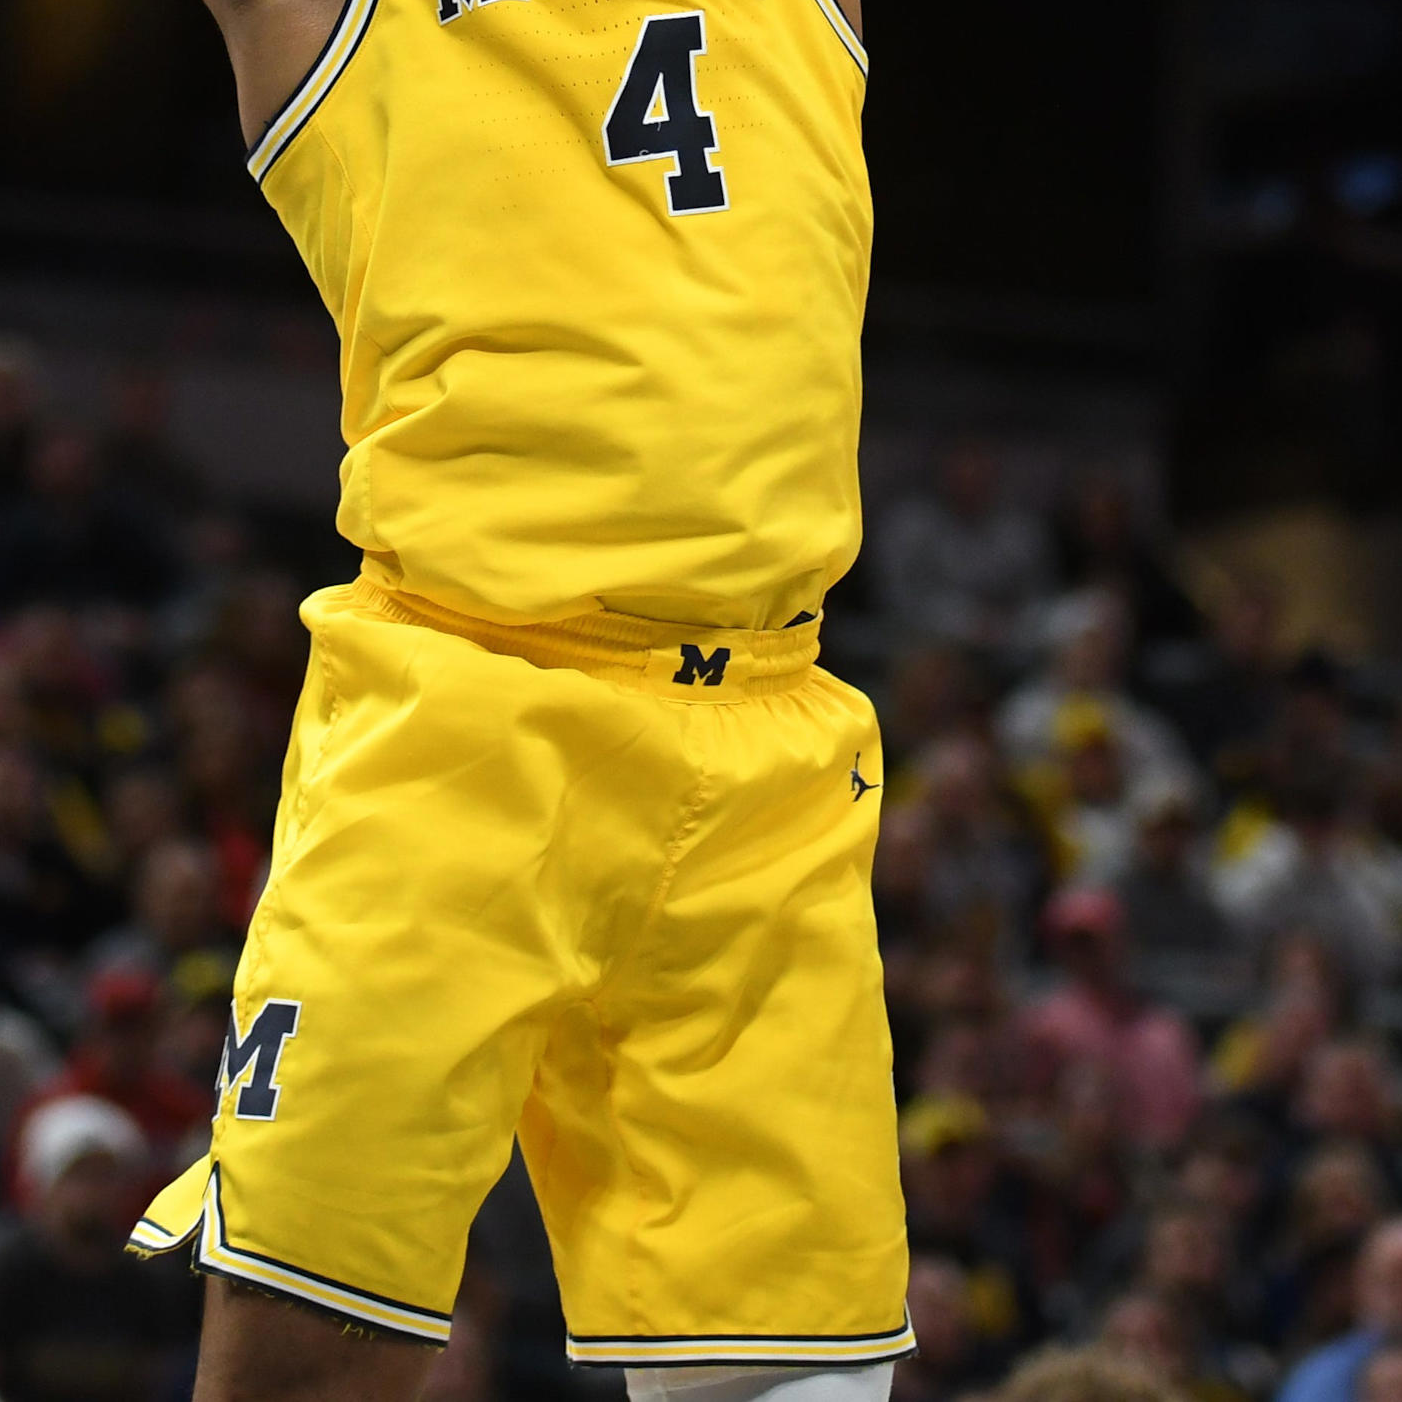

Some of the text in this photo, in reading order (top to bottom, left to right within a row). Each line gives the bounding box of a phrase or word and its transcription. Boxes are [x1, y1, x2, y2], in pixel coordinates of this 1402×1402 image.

[602, 10, 730, 216] 4
[672, 643, 731, 686] M
[211, 998, 302, 1121] M
